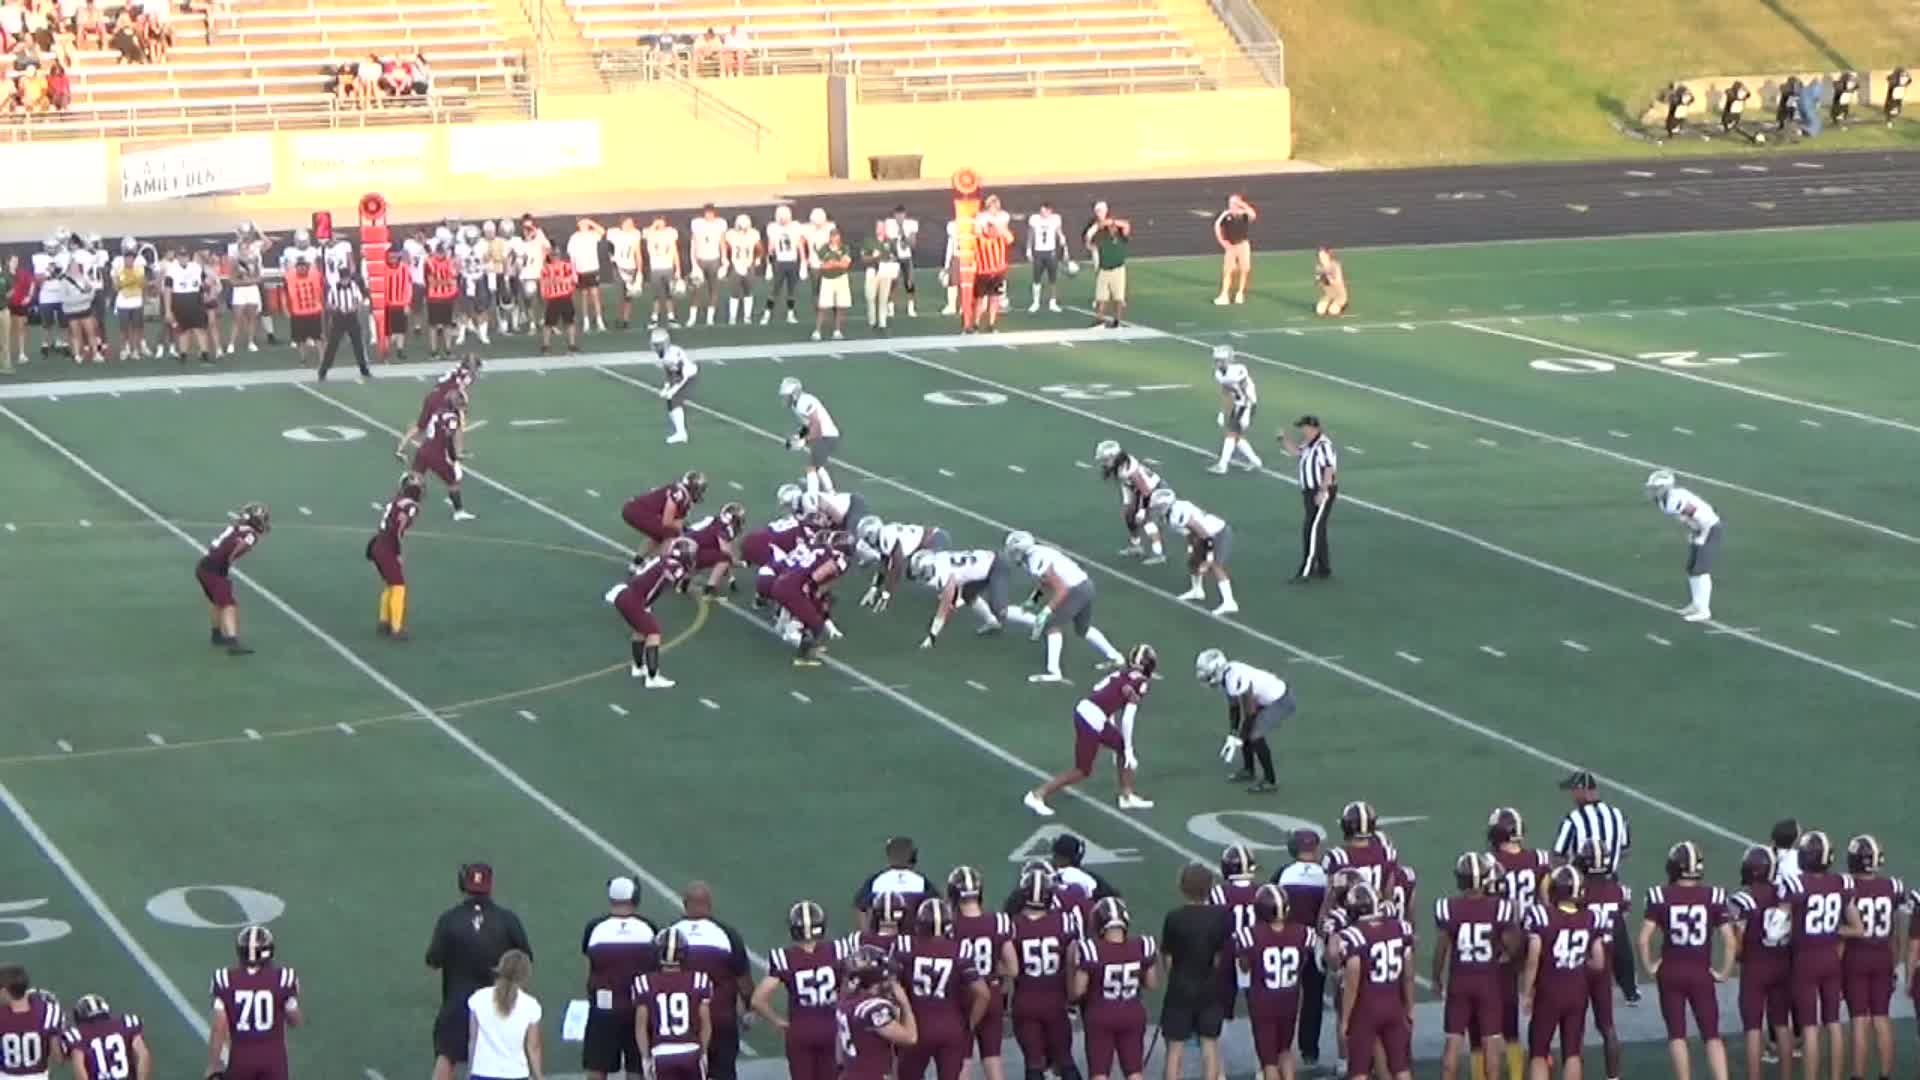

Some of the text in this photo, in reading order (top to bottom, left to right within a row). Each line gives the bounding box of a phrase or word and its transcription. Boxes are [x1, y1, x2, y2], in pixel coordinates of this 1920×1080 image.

[146, 885, 286, 928] 0
[1505, 869, 1536, 914] 12
[1669, 905, 1708, 946] 53
[1805, 892, 1841, 935] 28
[1857, 897, 1892, 938] 33
[1022, 937, 1060, 977] 56
[1369, 938, 1403, 983] 35
[1457, 922, 1493, 962] 45
[1553, 928, 1590, 969] 42
[795, 966, 837, 1006] 52
[913, 956, 953, 998] 57
[1103, 961, 1140, 999] 55
[1263, 946, 1299, 989] 92
[235, 989, 273, 1031] 70
[656, 992, 690, 1036] 19
[1, 1031, 41, 1067] 80
[90, 1034, 129, 1080] 13
